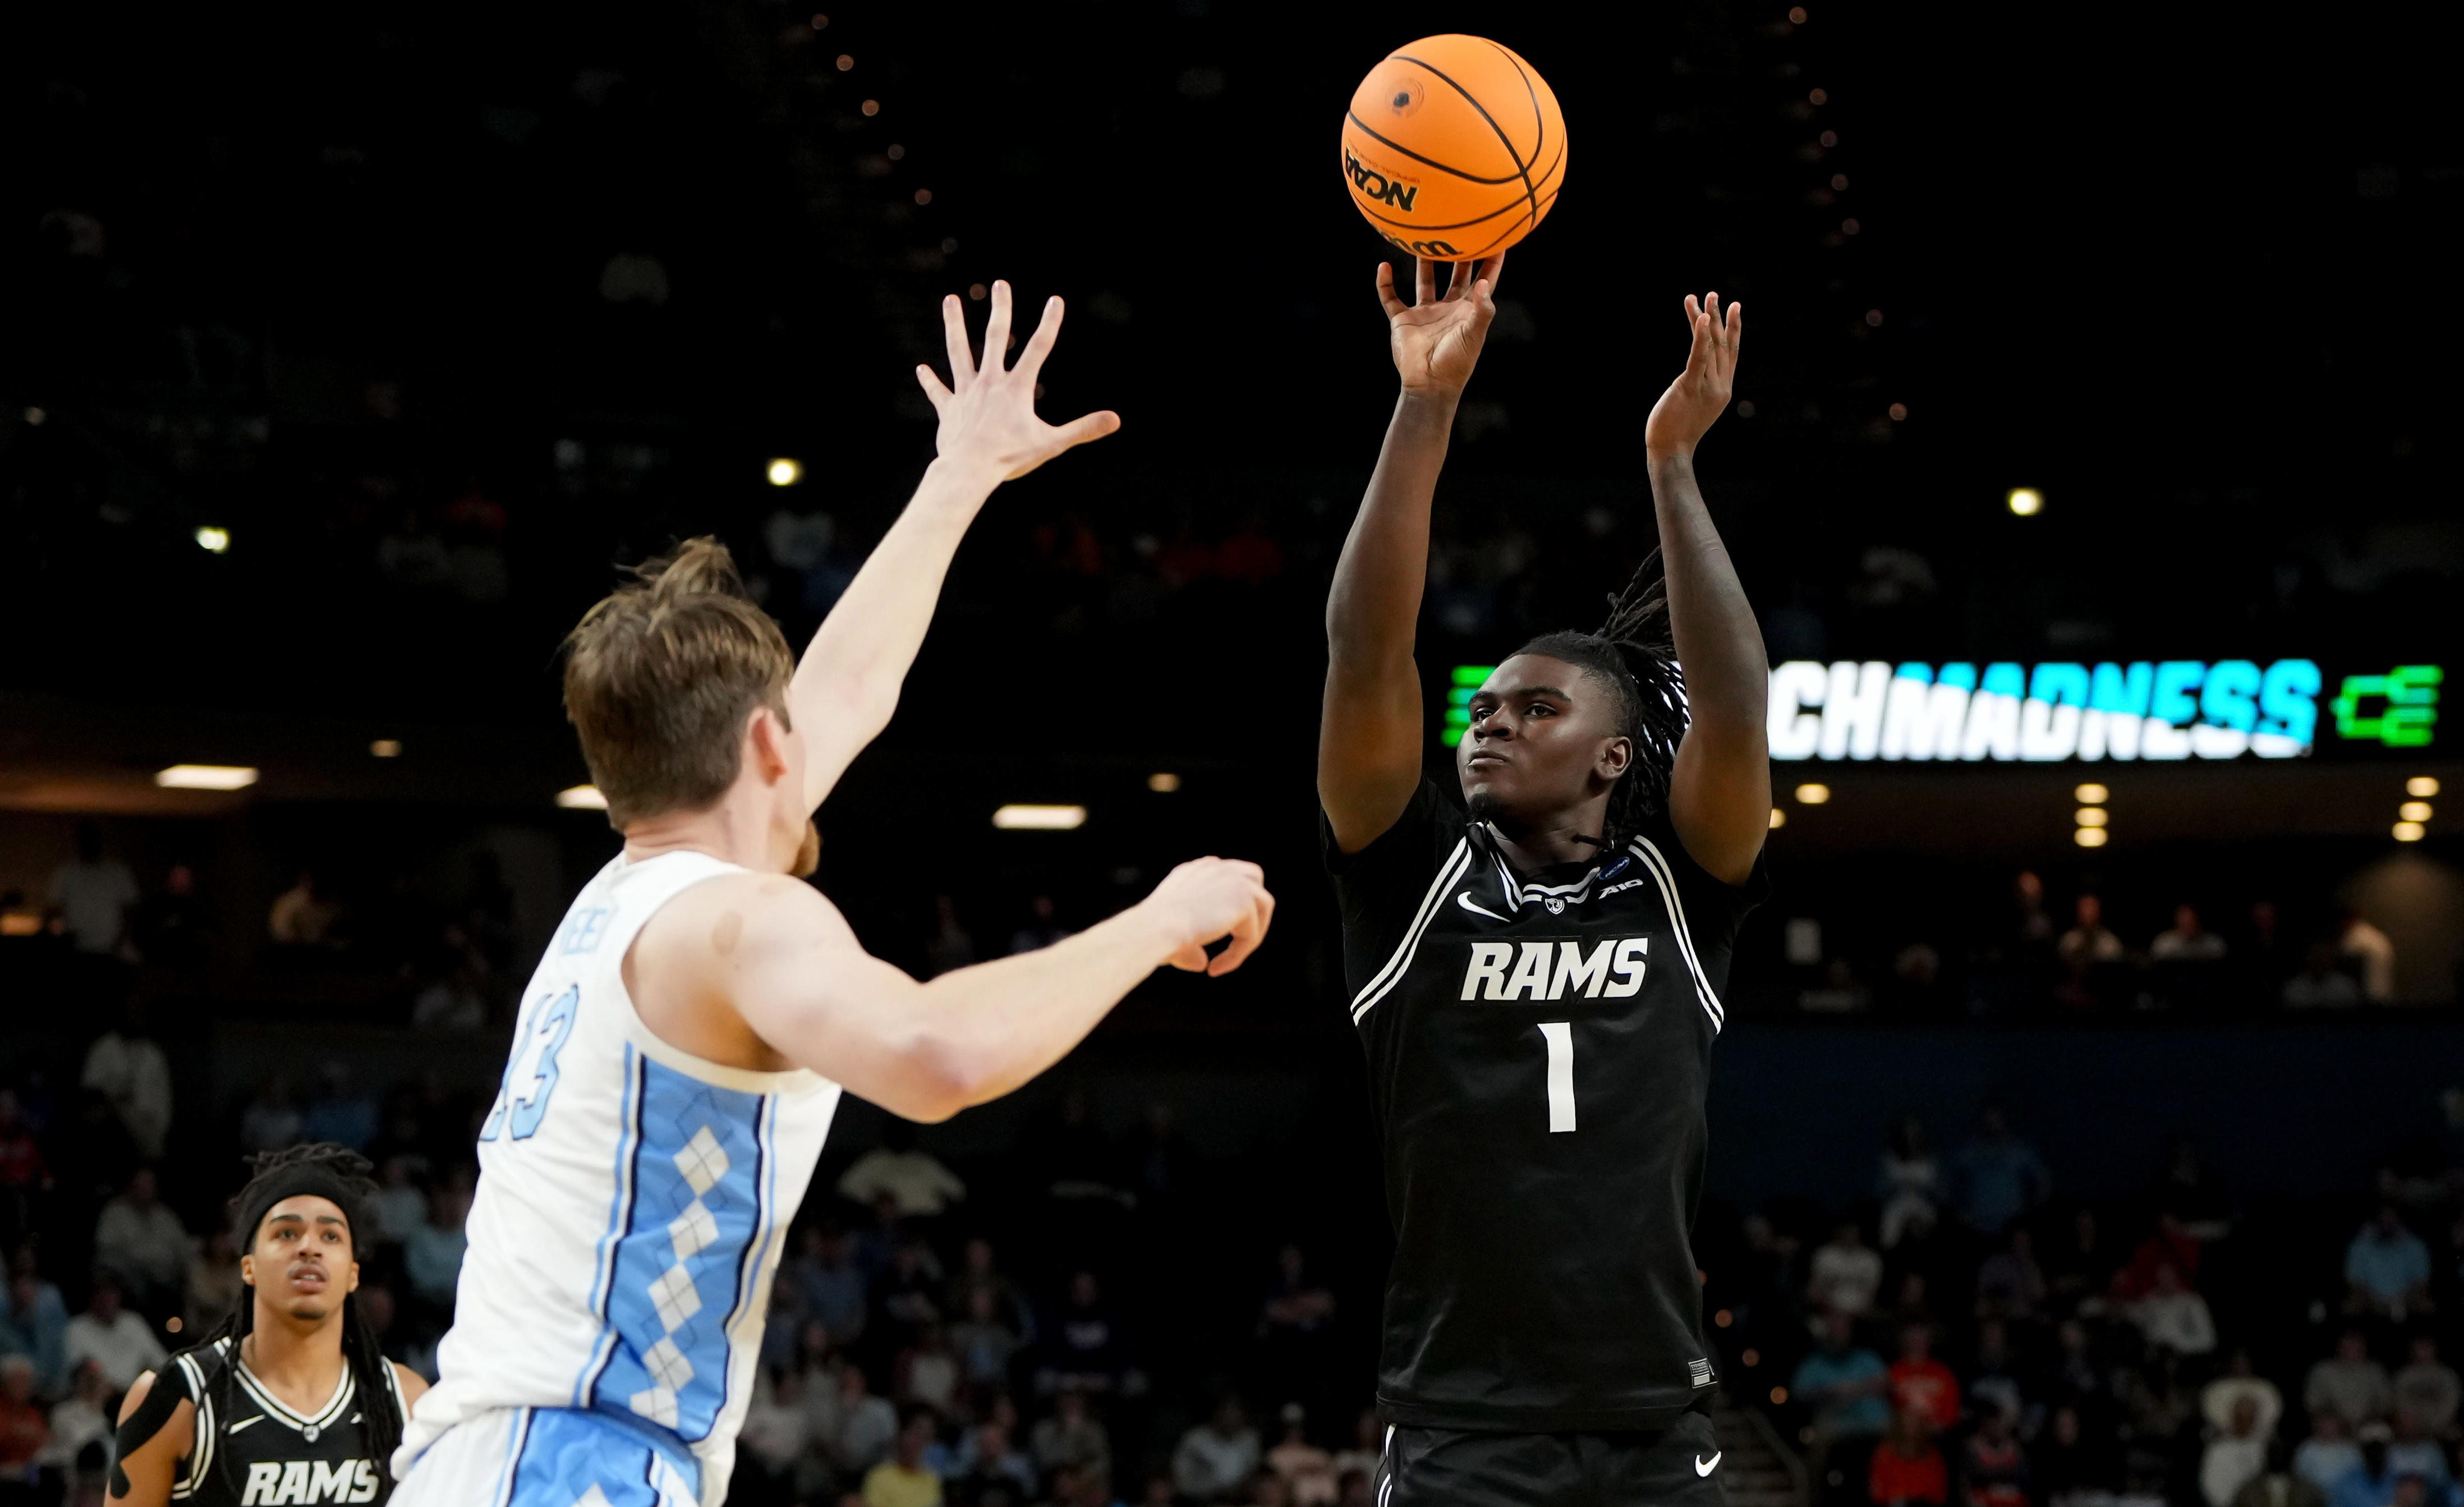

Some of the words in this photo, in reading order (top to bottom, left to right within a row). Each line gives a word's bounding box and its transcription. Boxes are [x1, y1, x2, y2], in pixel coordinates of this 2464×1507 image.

[1345, 146, 1419, 213] NCAA
[1767, 659, 2322, 761] CHMADNESS
[1598, 879, 1644, 900] A10
[1460, 938, 1648, 1001] RAMS
[479, 983, 580, 1142] 13
[1537, 1022, 1576, 1133] 1
[241, 1459, 379, 1507] RAMS
